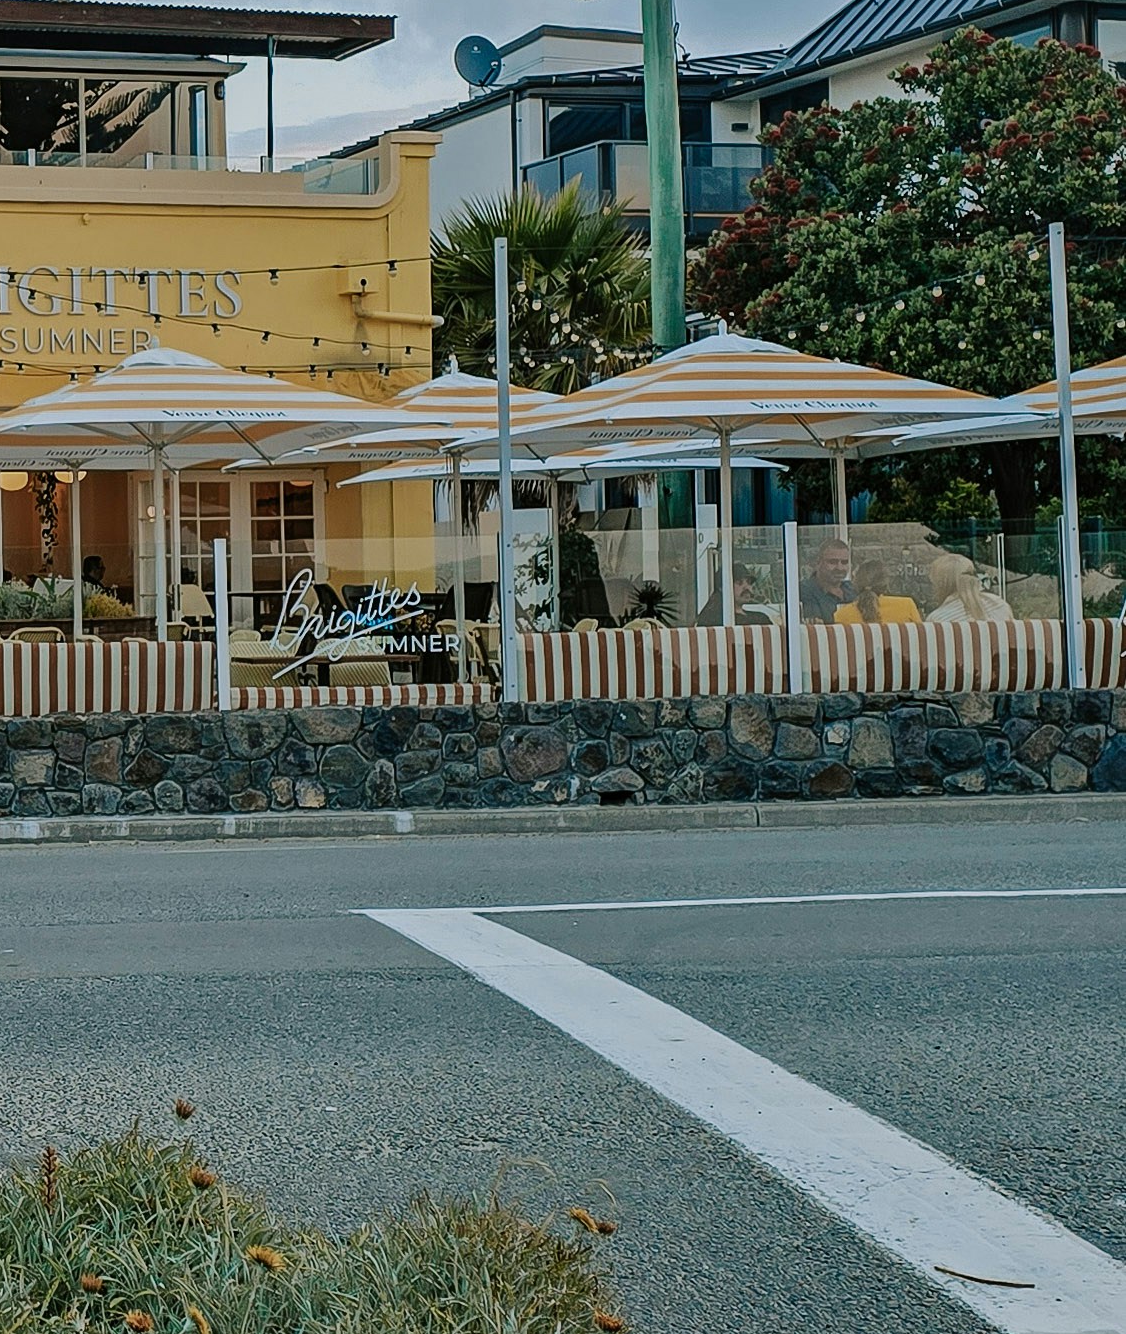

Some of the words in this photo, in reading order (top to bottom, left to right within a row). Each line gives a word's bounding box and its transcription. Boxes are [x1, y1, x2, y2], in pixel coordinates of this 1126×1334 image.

[0, 326, 152, 355] SUMNER
[271, 567, 422, 662] Brigittes
[358, 633, 461, 653] SUMNER
